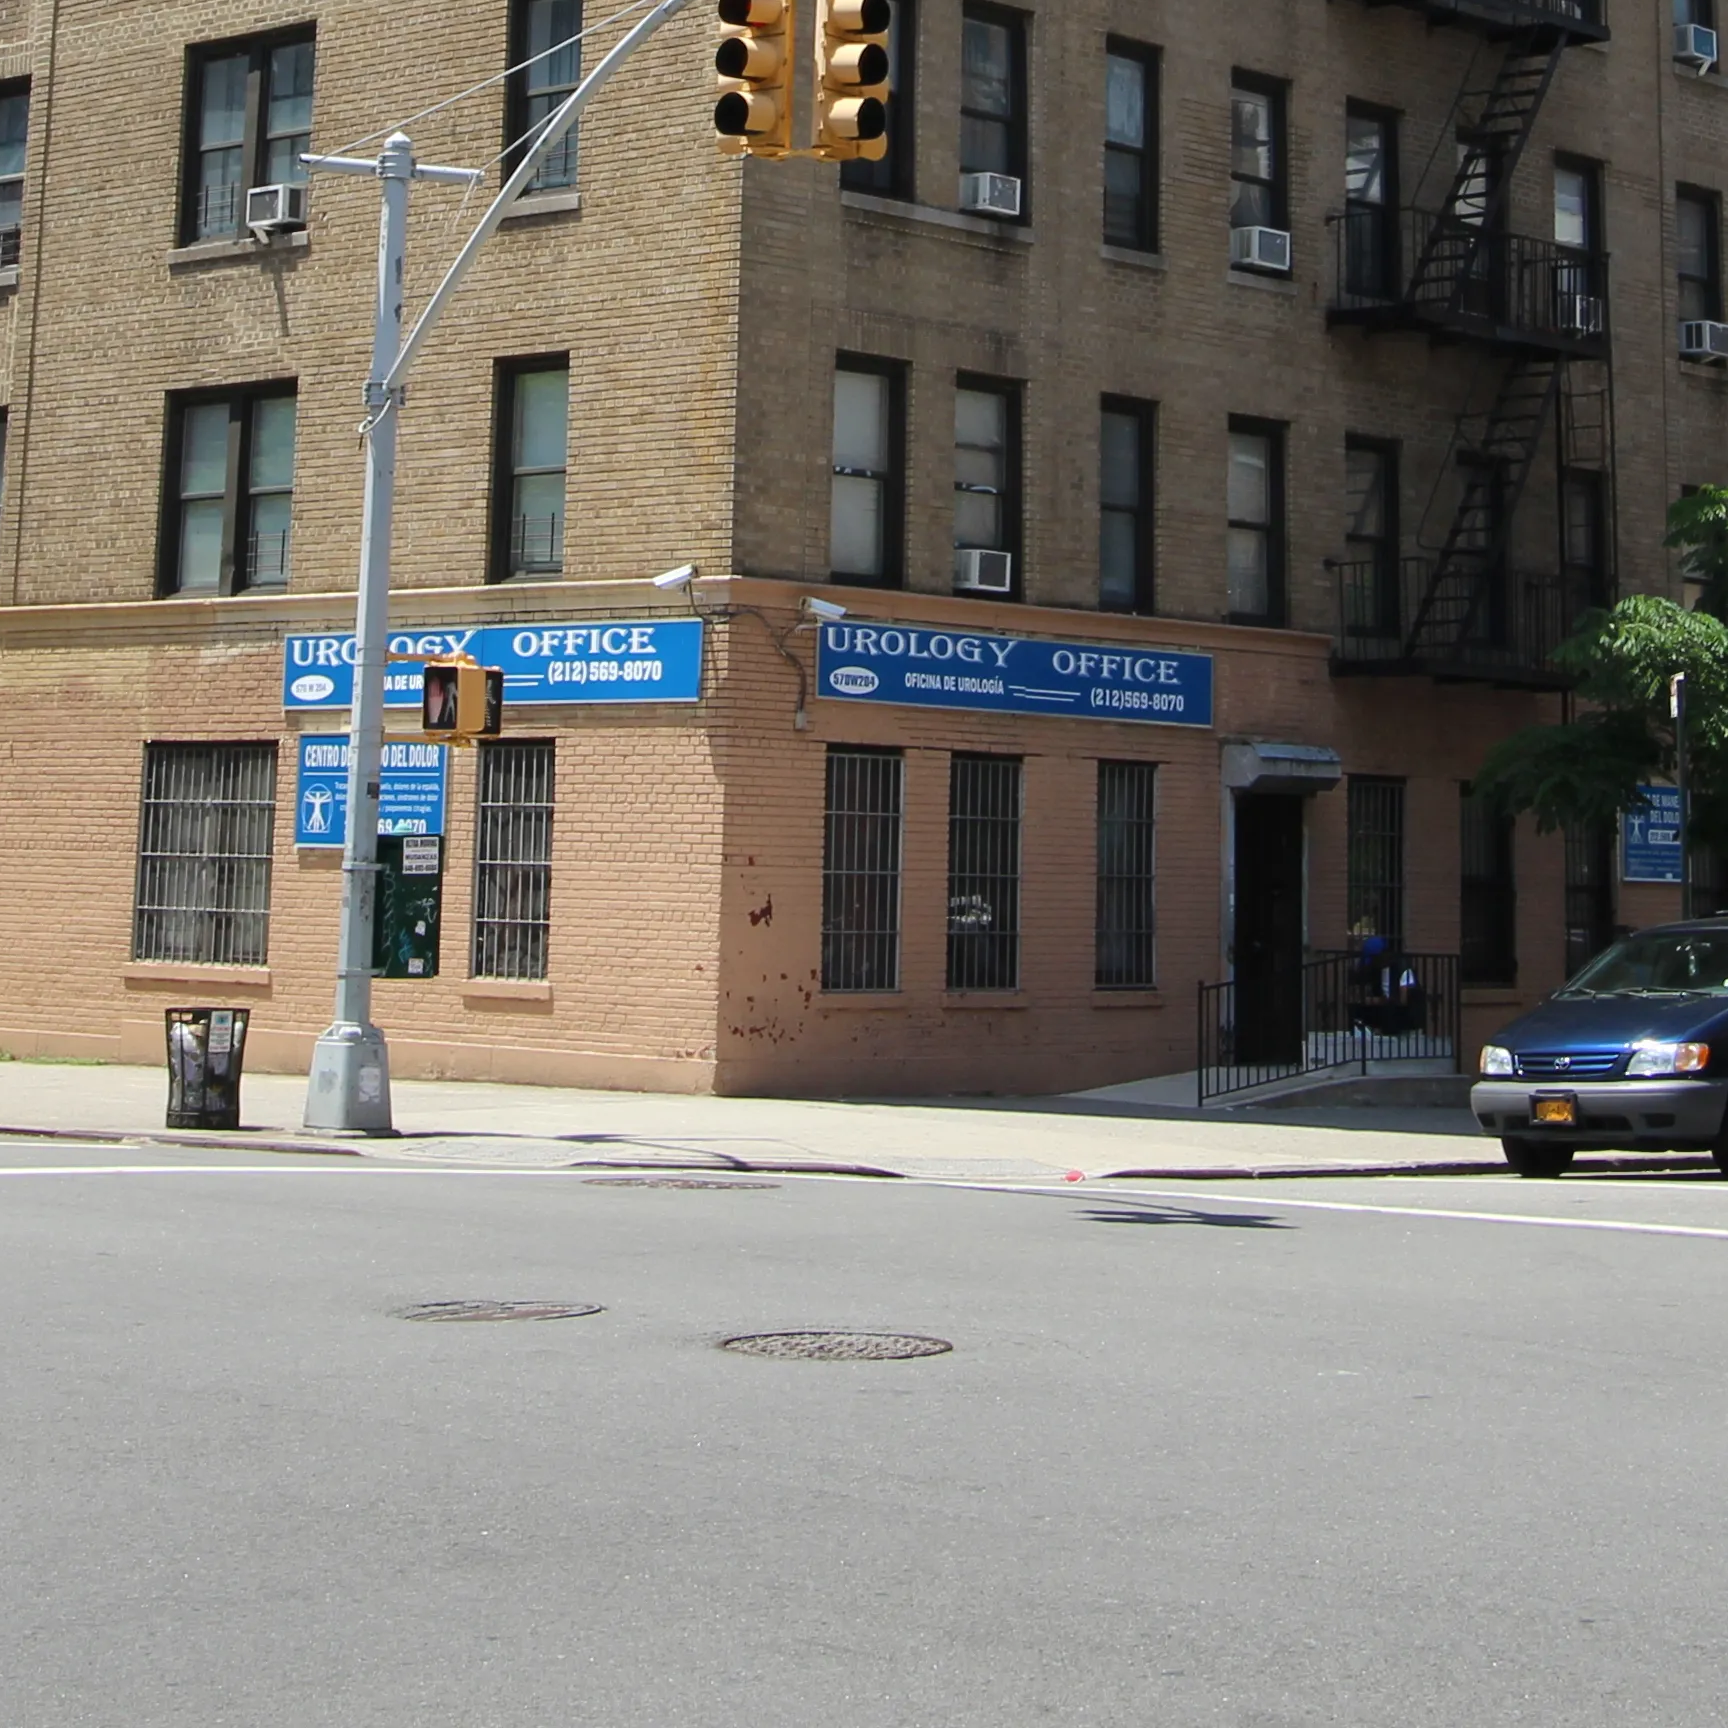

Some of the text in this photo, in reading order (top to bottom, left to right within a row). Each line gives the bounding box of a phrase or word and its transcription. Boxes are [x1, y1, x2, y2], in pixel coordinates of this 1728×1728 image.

[292, 627, 657, 667] UROOGY OFFICE
[826, 626, 1182, 685] UROLOGY OFFICE
[904, 672, 1004, 695] OFICINA DE UROLOGÍA
[305, 744, 339, 768] CENTRO
[390, 745, 408, 768] DEL
[408, 745, 440, 768] DOLOR
